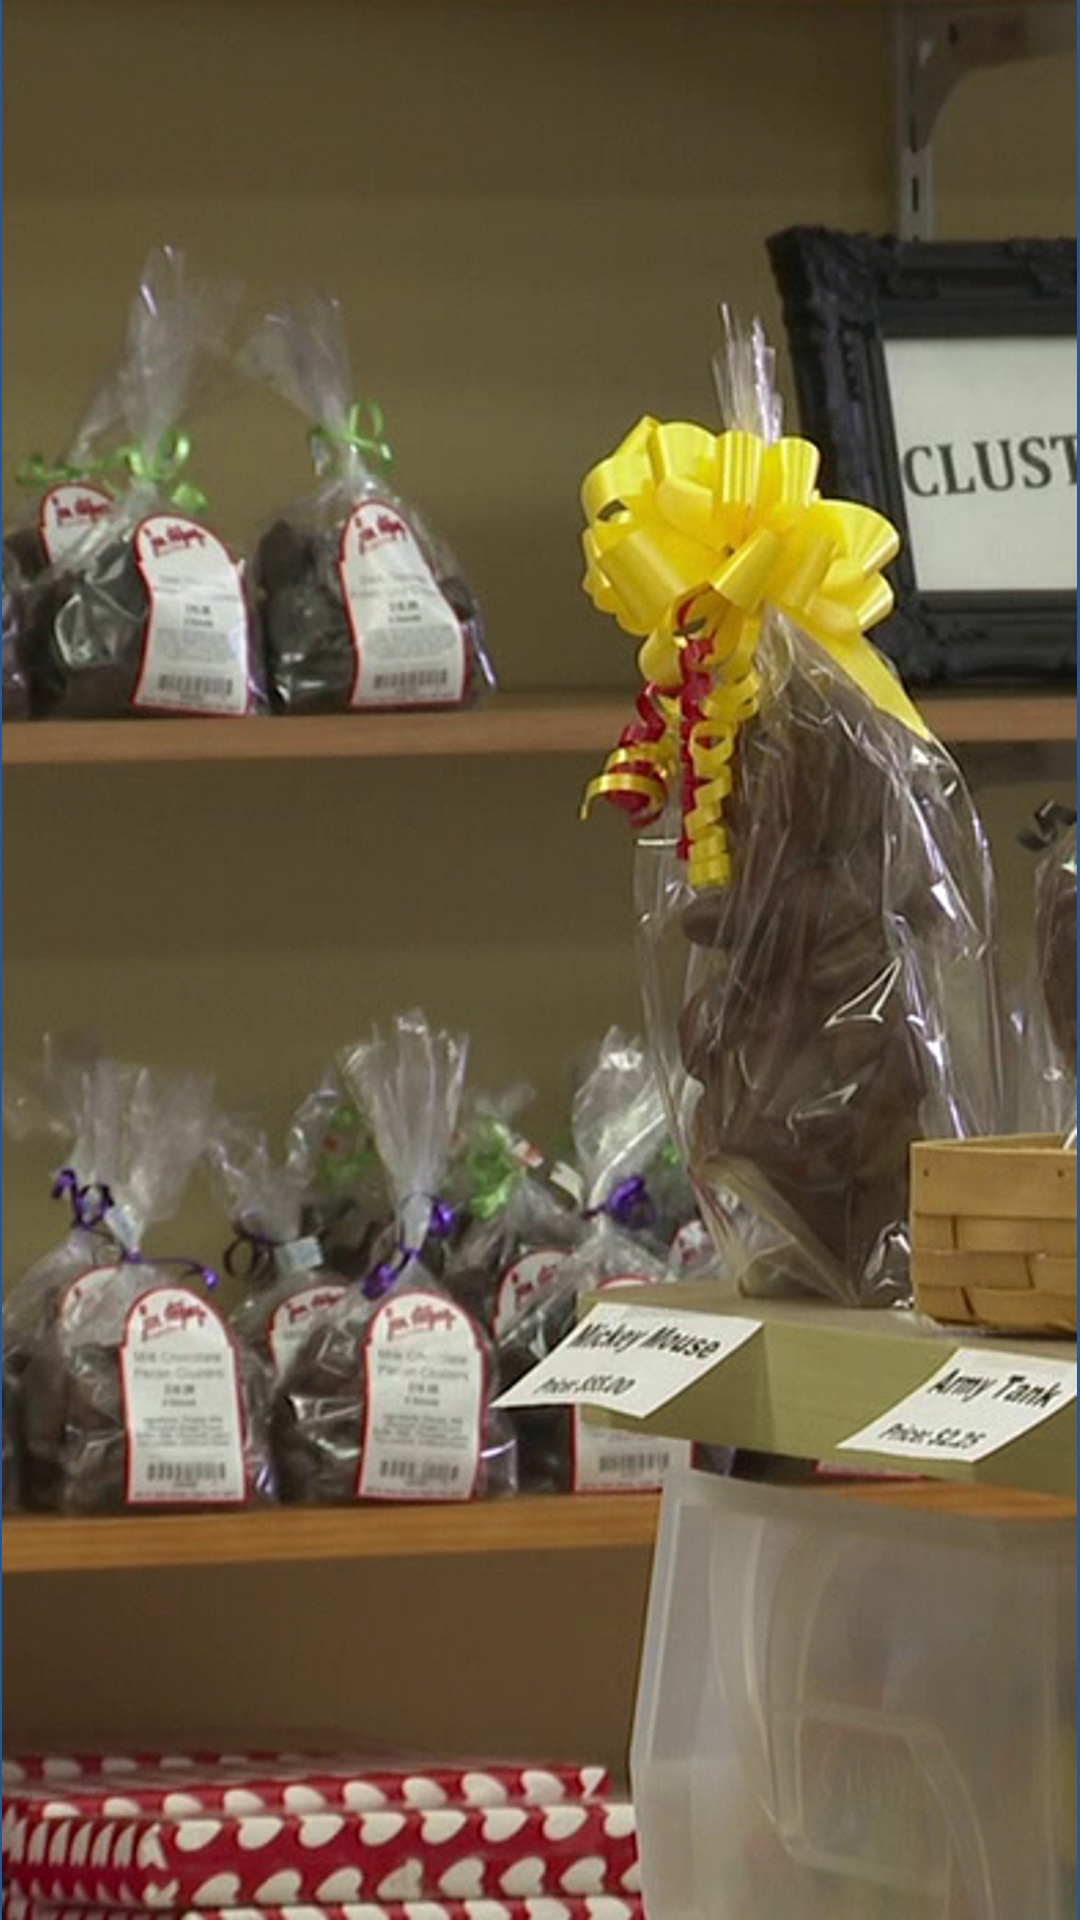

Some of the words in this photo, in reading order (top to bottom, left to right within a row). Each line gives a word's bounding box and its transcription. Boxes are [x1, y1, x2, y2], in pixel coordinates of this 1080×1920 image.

[566, 1322, 645, 1353] Mickey
[637, 1325, 721, 1359] Mouse
[926, 1368, 997, 1402] Army
[992, 1374, 1063, 1407] Tank
[877, 1422, 931, 1444] Price:
[927, 1428, 986, 1449] $2.25
